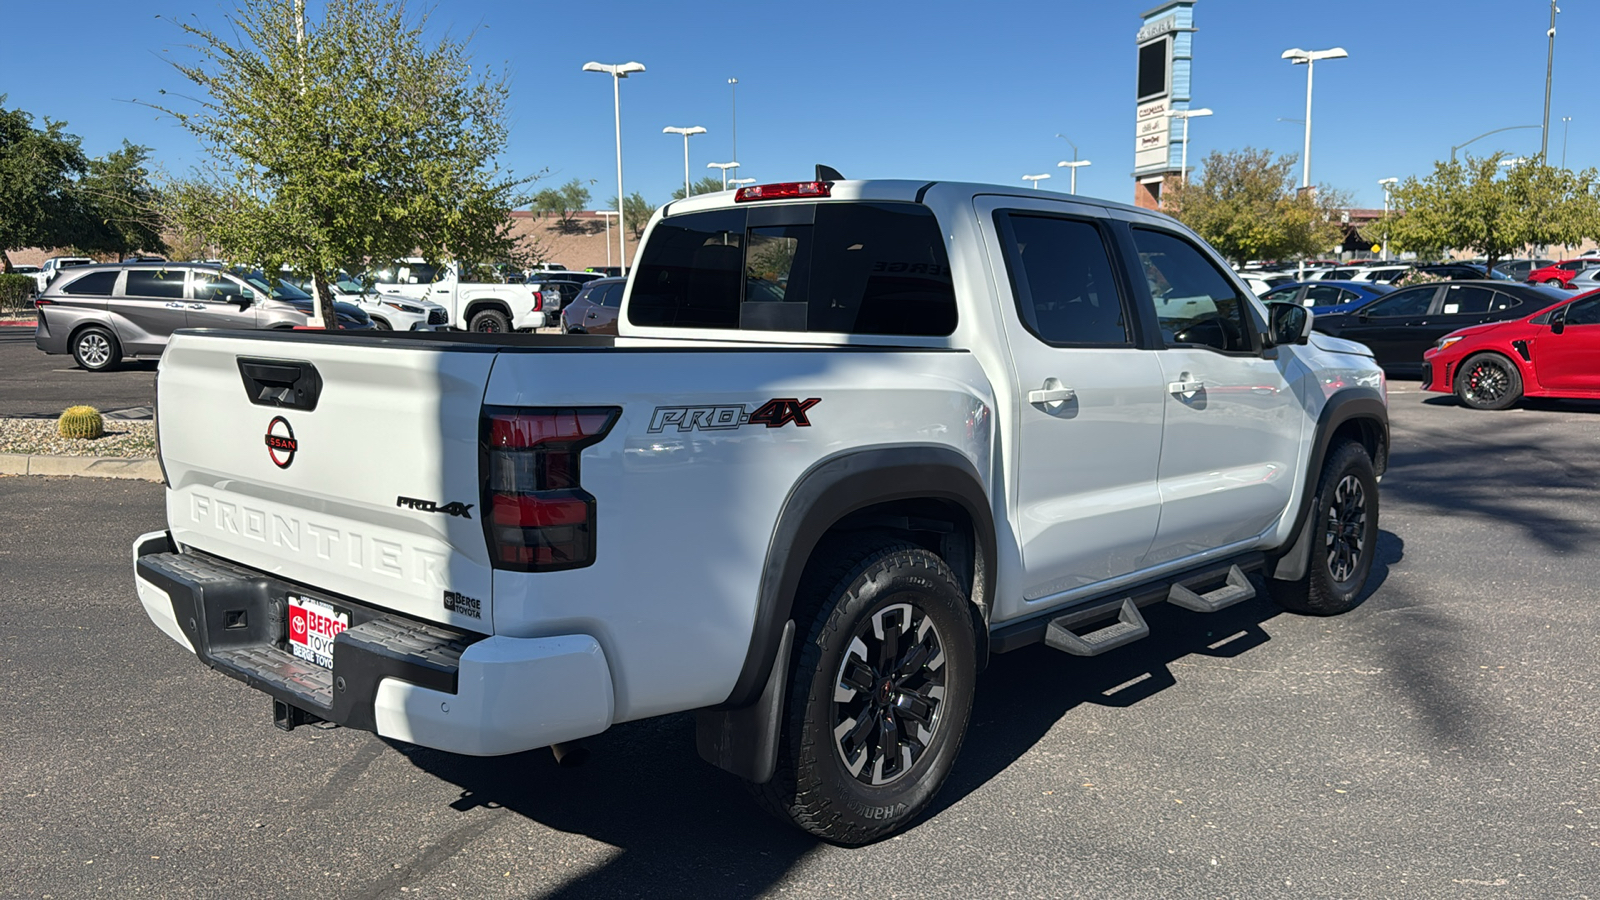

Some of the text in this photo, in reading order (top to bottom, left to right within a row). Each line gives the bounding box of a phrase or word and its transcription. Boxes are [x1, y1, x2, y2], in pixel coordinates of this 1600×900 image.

[647, 398, 822, 433] PRO-4X
[266, 437, 296, 450] SSAN
[397, 496, 475, 519] PRO-4X
[190, 492, 452, 588] FRONTIER
[455, 592, 481, 610] BERGE
[455, 605, 482, 620] TOYOTA
[309, 635, 334, 656] TOYO
[315, 653, 334, 670] TOYO
